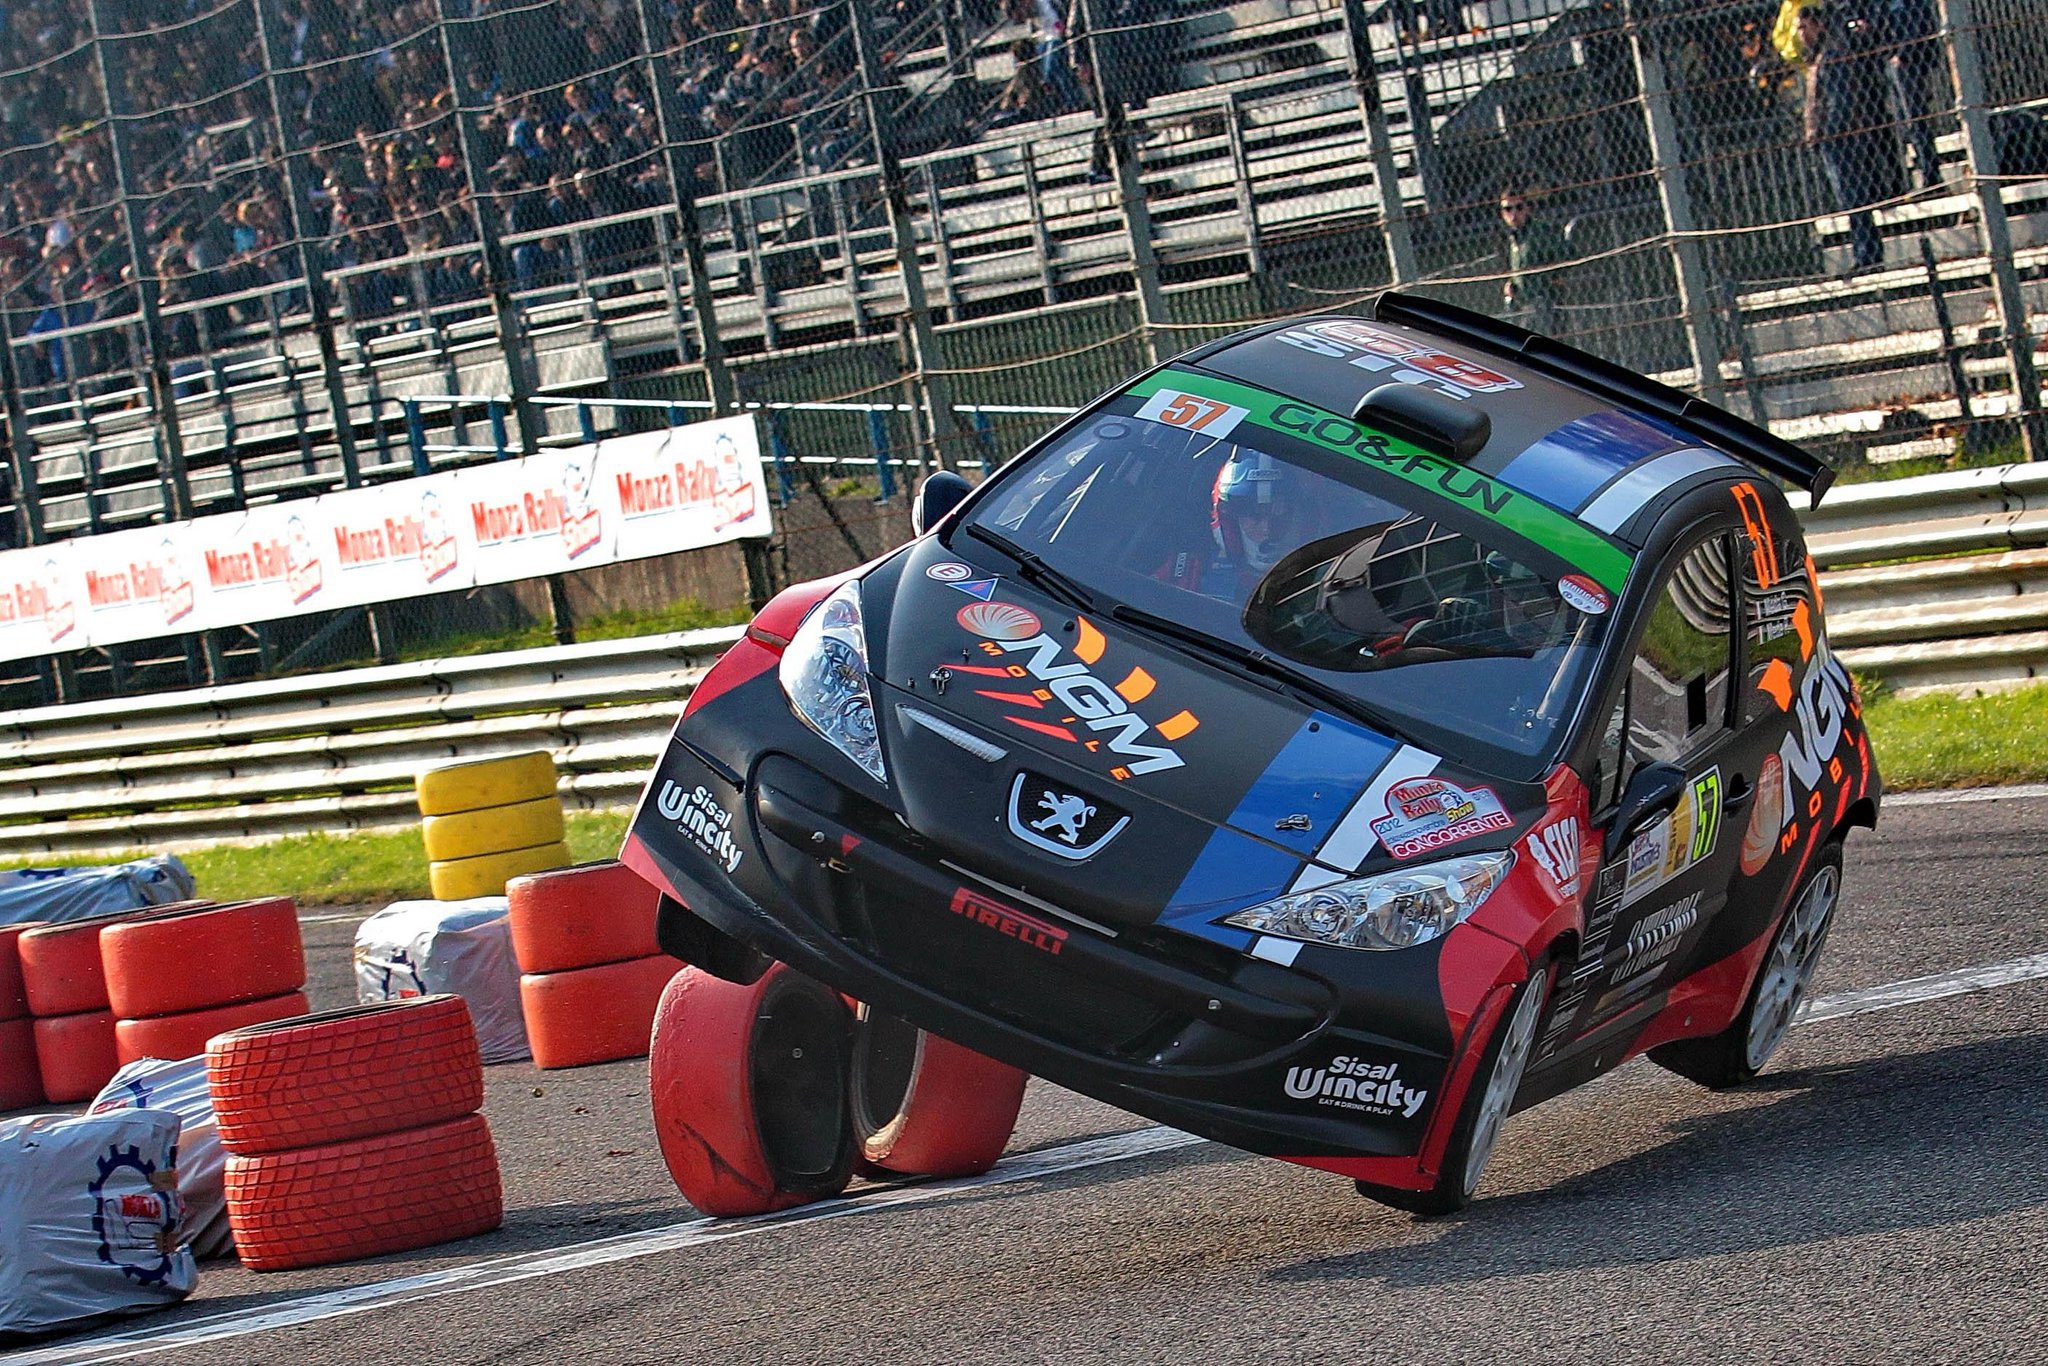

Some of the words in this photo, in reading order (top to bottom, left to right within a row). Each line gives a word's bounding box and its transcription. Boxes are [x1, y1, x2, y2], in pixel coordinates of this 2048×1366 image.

[1159, 394, 1231, 431] 57
[1269, 403, 1514, 515] GO&FUN
[616, 472, 673, 515] Monza
[675, 459, 718, 506] Rally
[471, 501, 523, 543] Monza
[978, 641, 1131, 781] MOBILE
[995, 632, 1187, 777] NGM
[657, 779, 743, 874] Wincity
[691, 785, 733, 829] Sisal
[1375, 818, 1404, 834] 2012
[1446, 801, 1475, 823] Show
[1692, 774, 1719, 861] 57
[1393, 812, 1510, 857] CONCORRENTE
[950, 886, 1069, 955] PIRELLI
[1284, 1066, 1428, 1119] Wincity
[1328, 1055, 1399, 1081] Sisal
[1318, 1097, 1335, 1107] EAT
[1340, 1101, 1366, 1112] DRINK
[1372, 1106, 1394, 1117] PLAY
